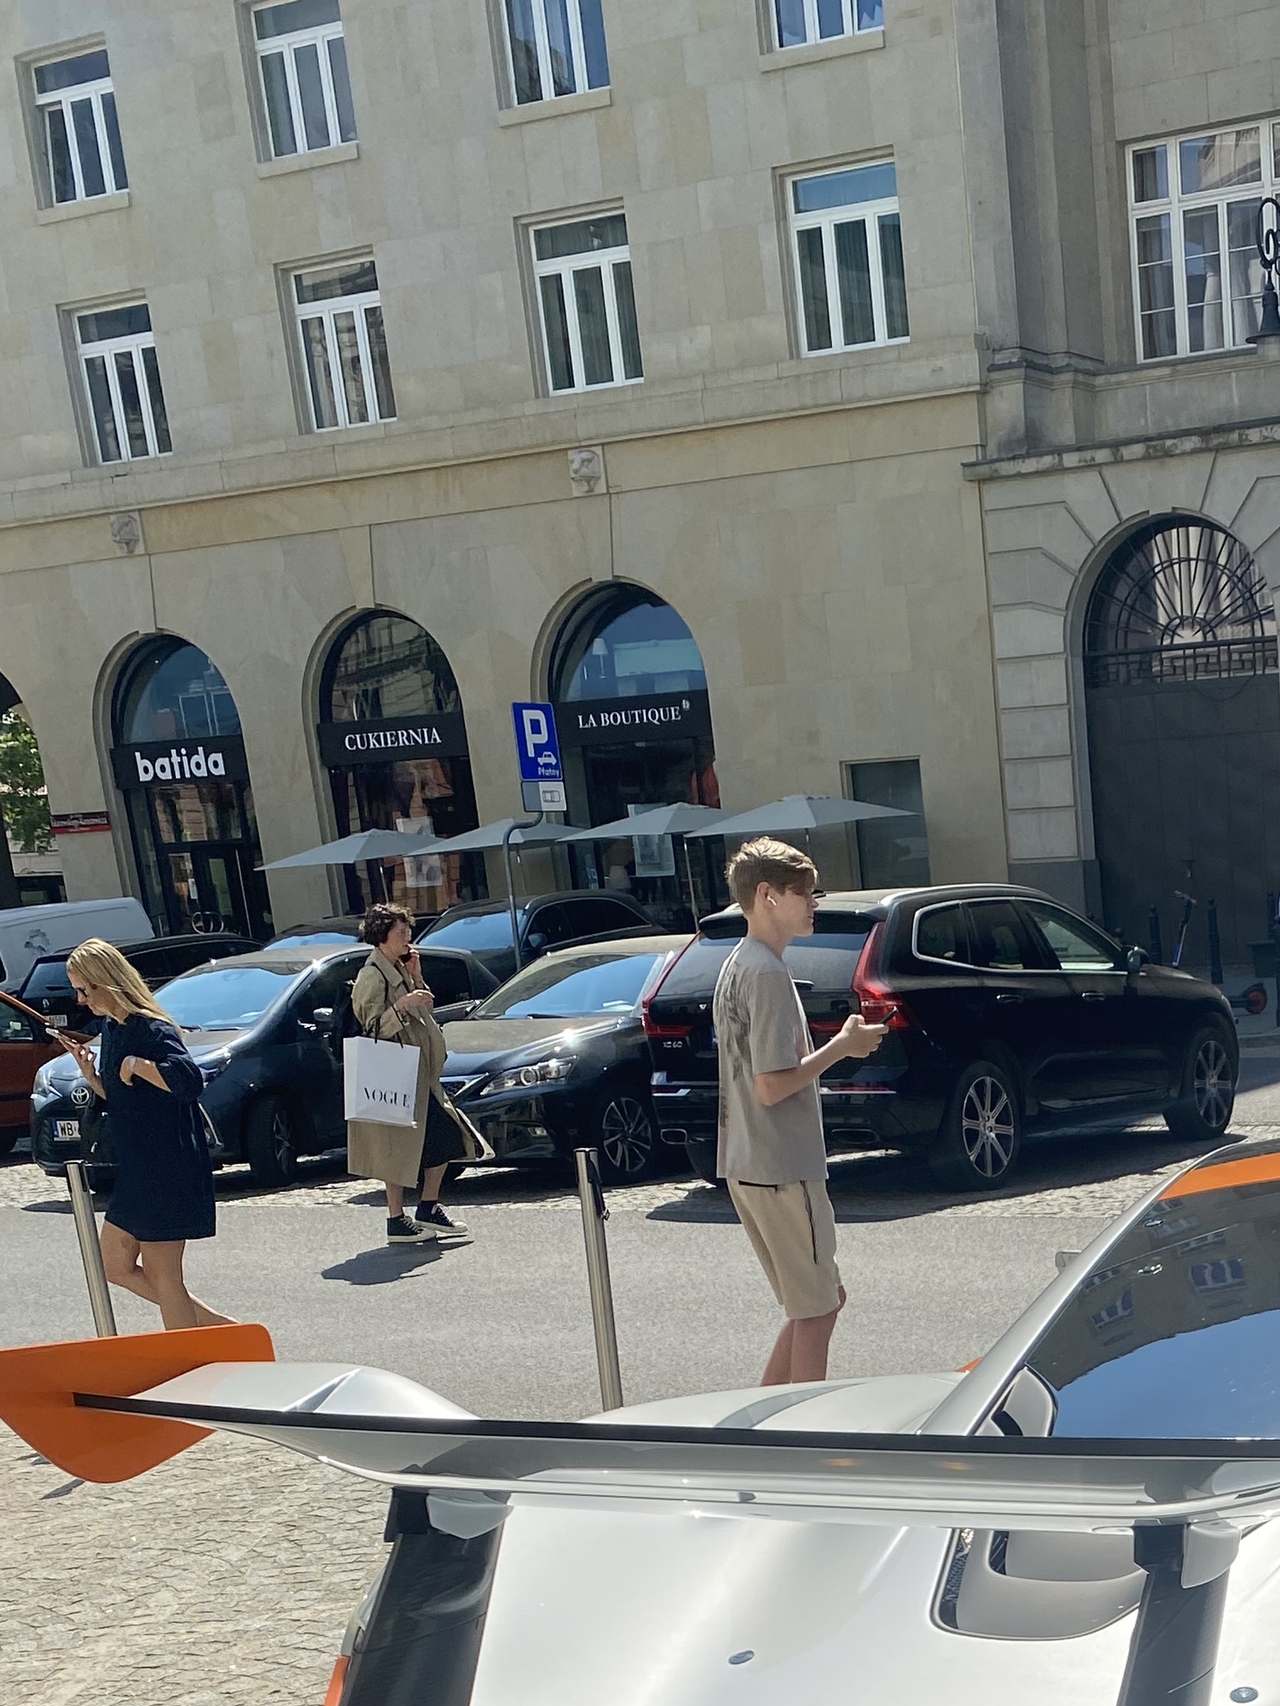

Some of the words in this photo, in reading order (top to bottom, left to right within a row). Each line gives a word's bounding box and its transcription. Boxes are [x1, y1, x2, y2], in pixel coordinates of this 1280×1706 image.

[578, 714, 598, 729] LA
[600, 706, 681, 727] BOUTIQUE
[345, 727, 442, 751] CUKIERNIA
[522, 709, 548, 757] P
[135, 746, 226, 782] batida
[364, 1087, 411, 1109] VOGUE
